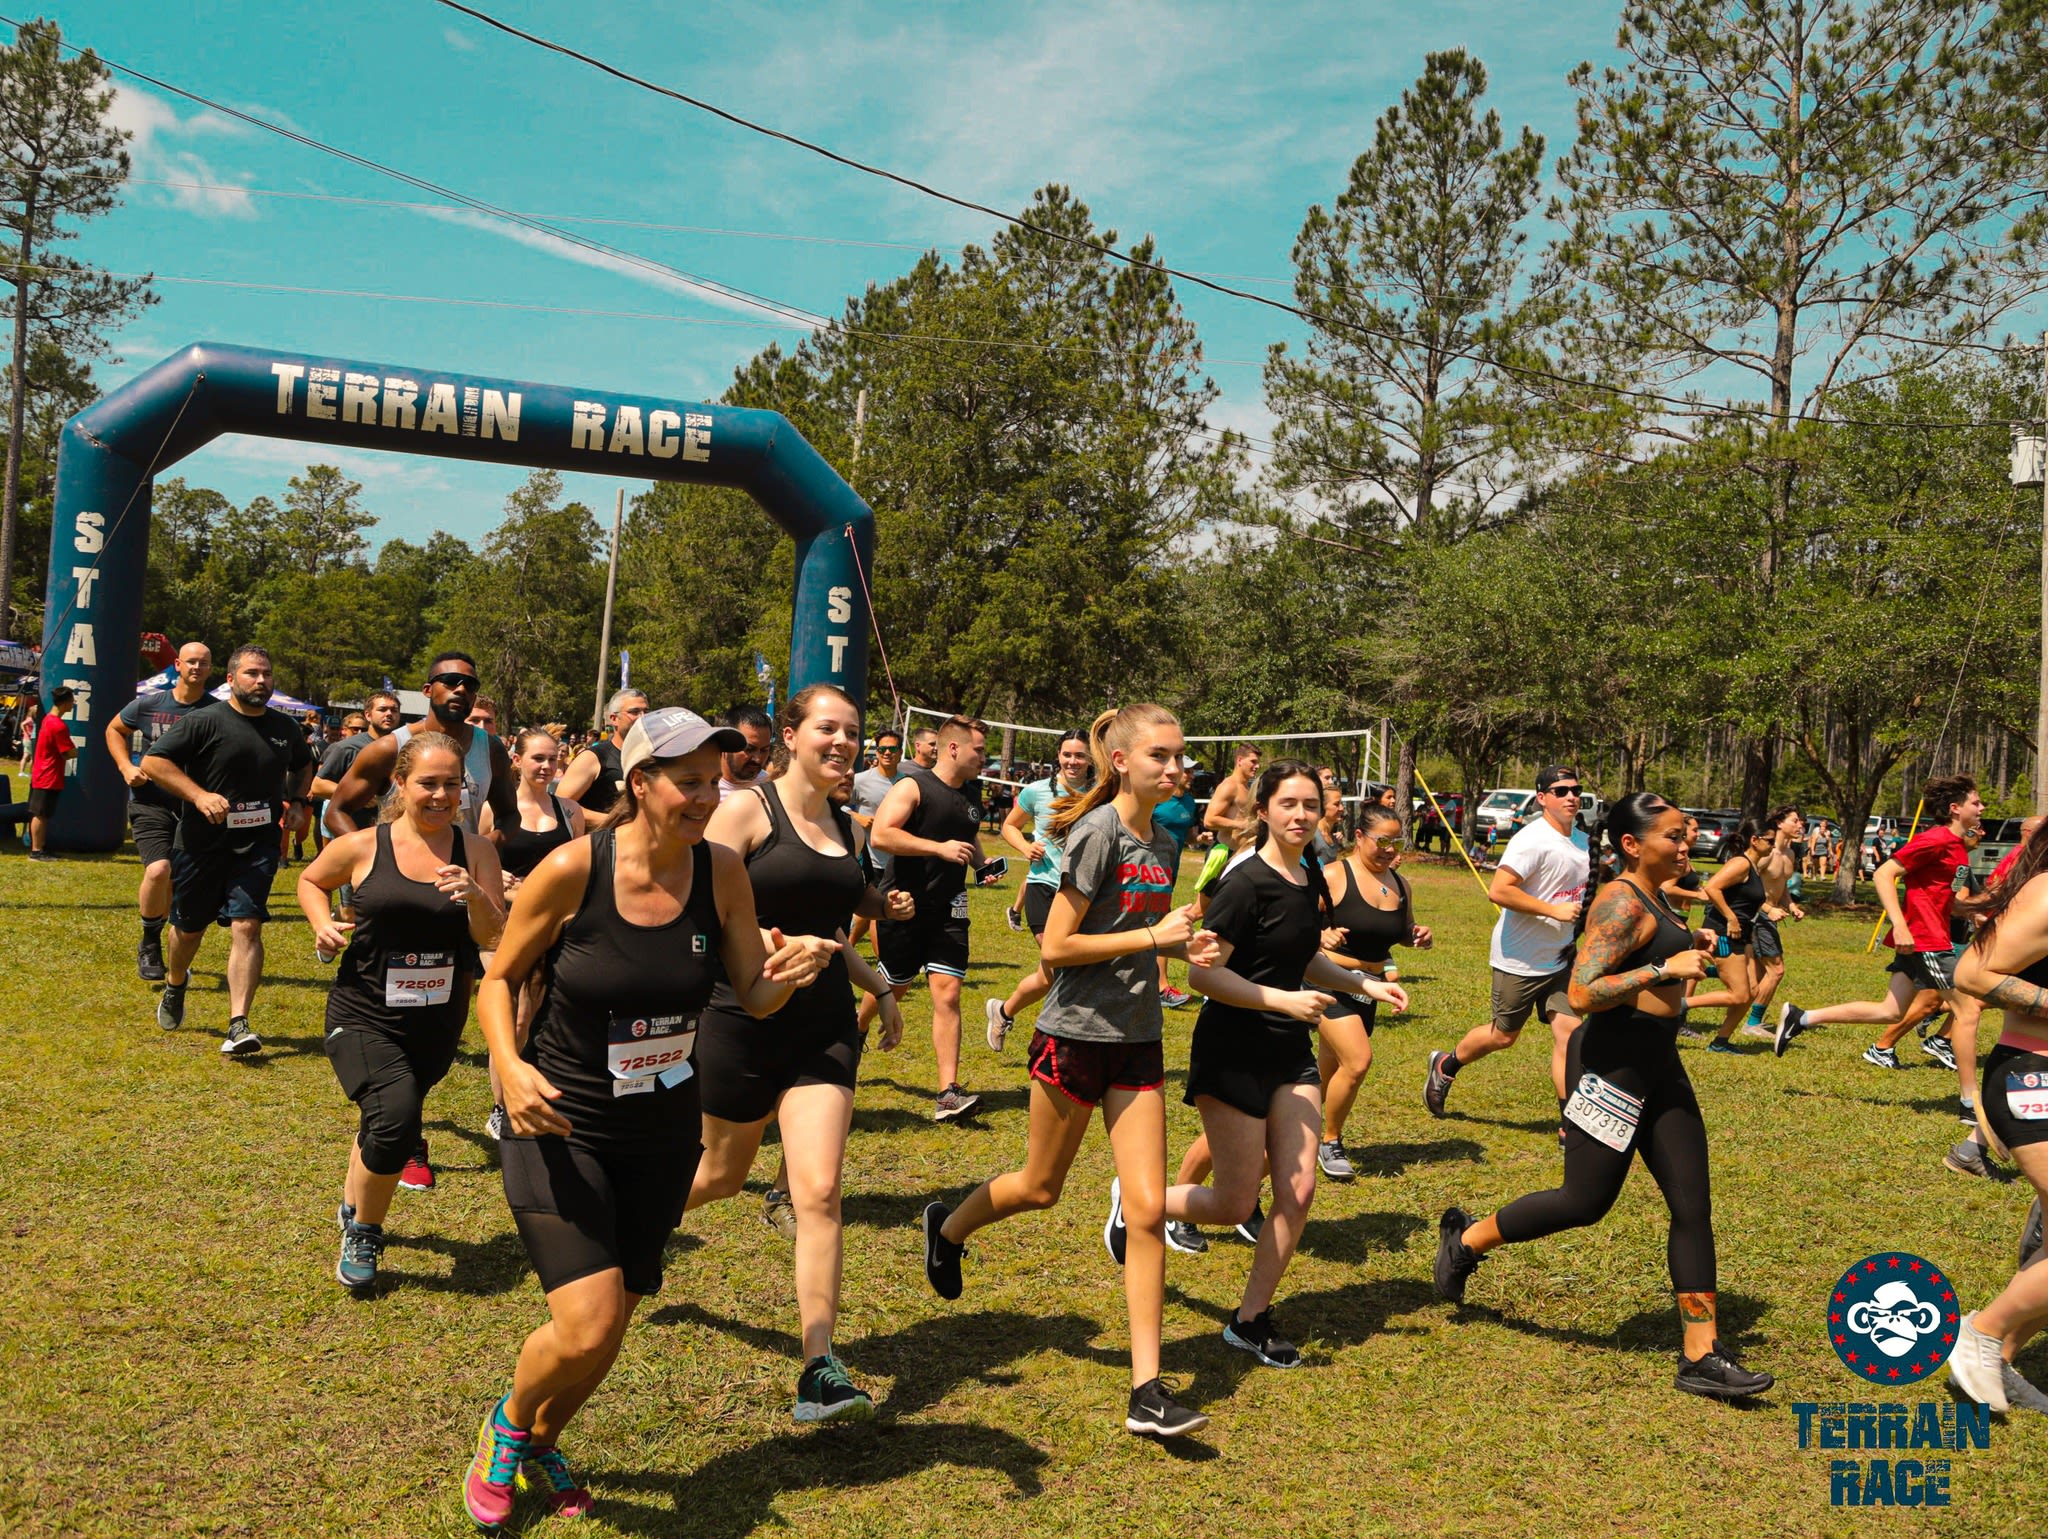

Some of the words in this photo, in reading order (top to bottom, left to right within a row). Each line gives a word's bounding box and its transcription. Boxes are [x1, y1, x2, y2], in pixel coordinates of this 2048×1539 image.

[271, 362, 522, 442] TERRAIN
[571, 400, 712, 463] RACE
[827, 586, 852, 691] ST
[395, 978, 446, 989] 72509
[620, 1050, 684, 1072] 72522
[1574, 1097, 1629, 1138] 307318
